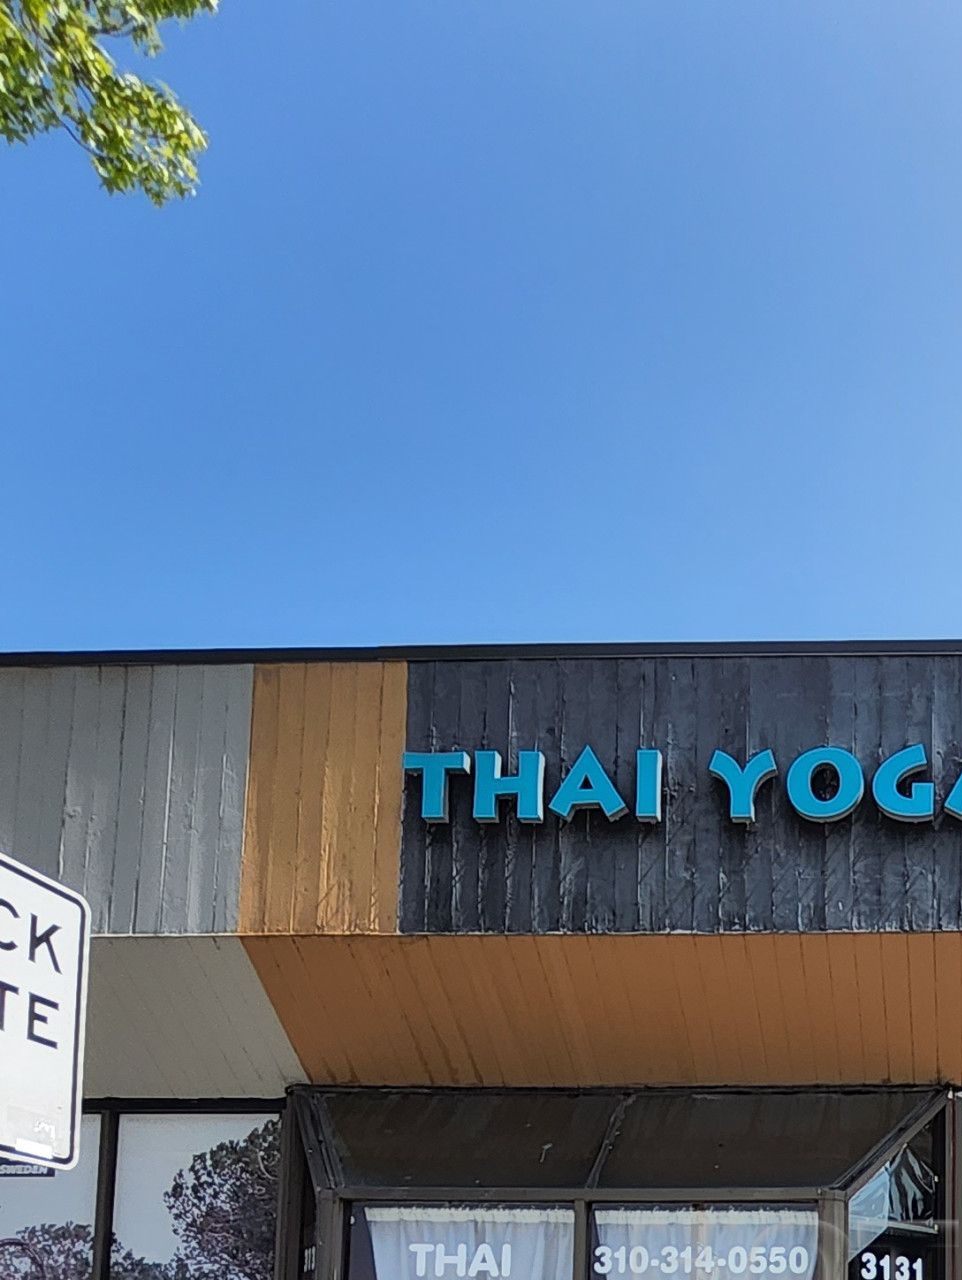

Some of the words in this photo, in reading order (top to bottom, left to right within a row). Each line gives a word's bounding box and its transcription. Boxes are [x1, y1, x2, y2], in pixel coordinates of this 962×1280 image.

[402, 745, 663, 823] THAI
[408, 1243, 512, 1278] THAI
[593, 1245, 809, 1275] 310-314-0550
